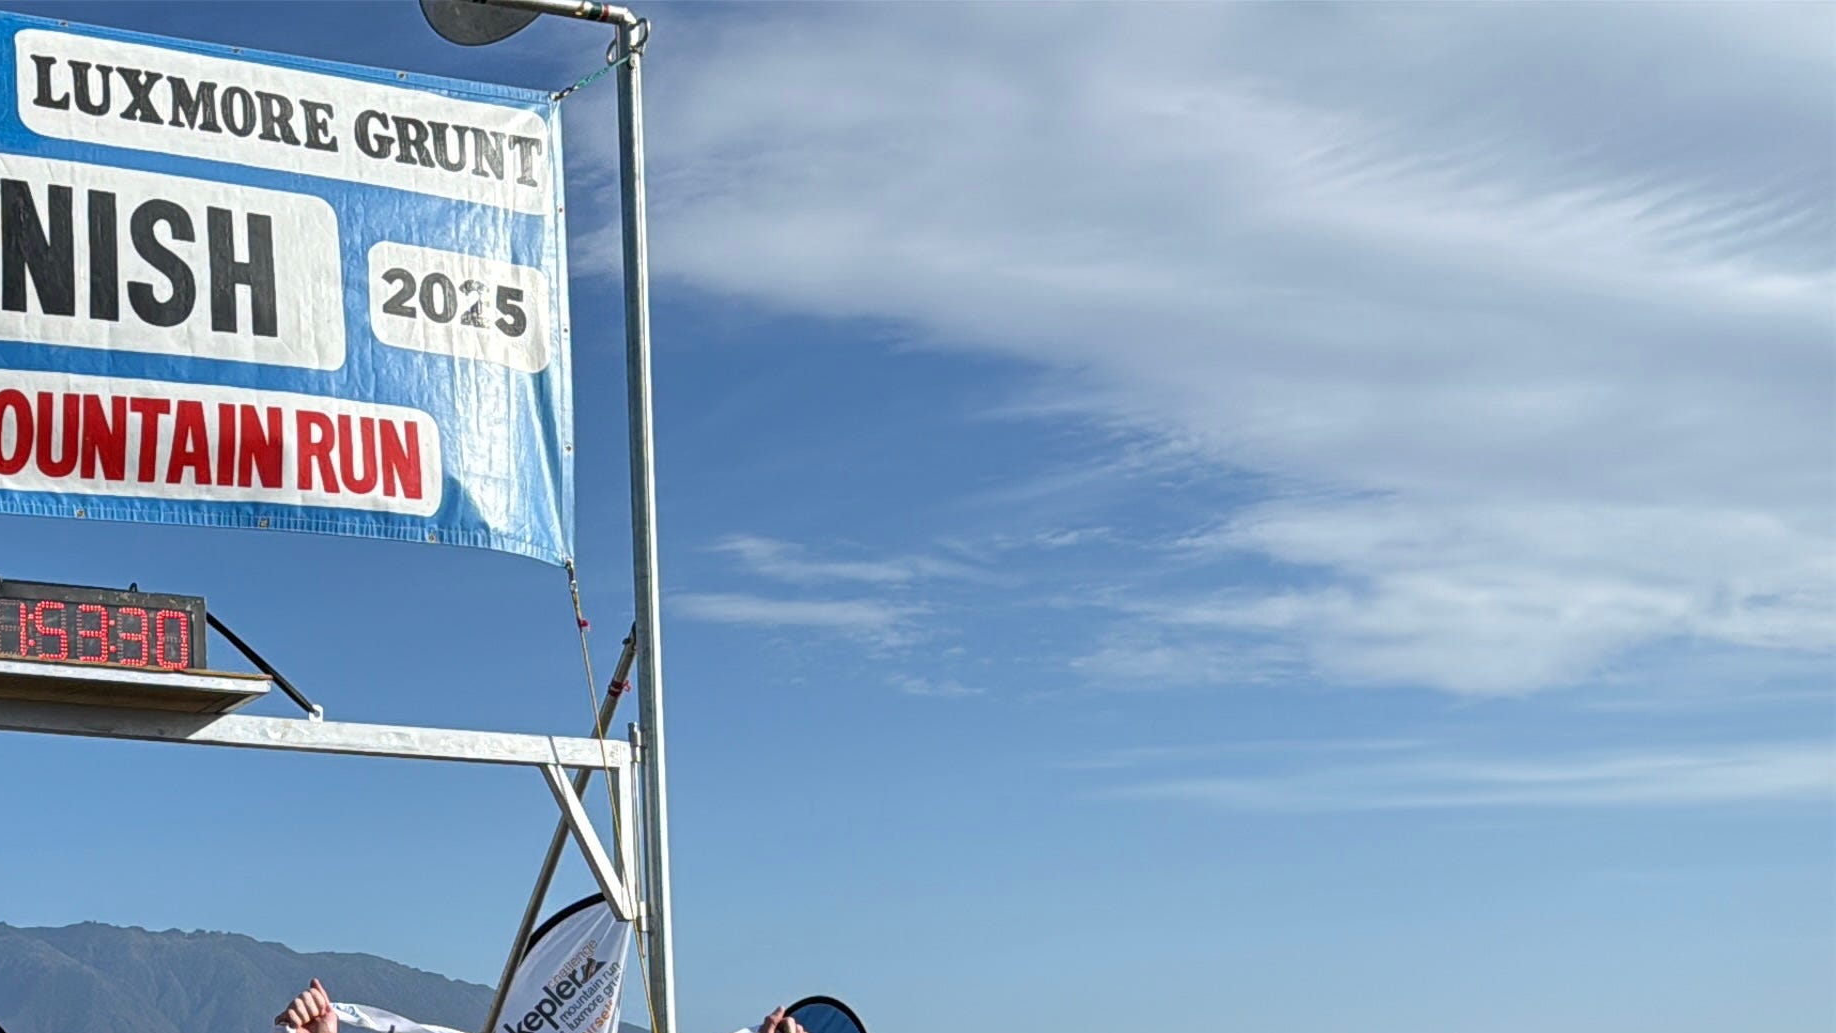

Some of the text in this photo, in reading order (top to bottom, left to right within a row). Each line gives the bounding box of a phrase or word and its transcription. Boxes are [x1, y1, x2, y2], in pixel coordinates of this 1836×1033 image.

[31, 53, 543, 188] LUXMORE GRUNT
[381, 265, 528, 340] 2025
[295, 415, 425, 501] RUN
[548, 939, 598, 989] challenge
[560, 961, 620, 1022] mountain run
[566, 994, 604, 1031] luxmore
